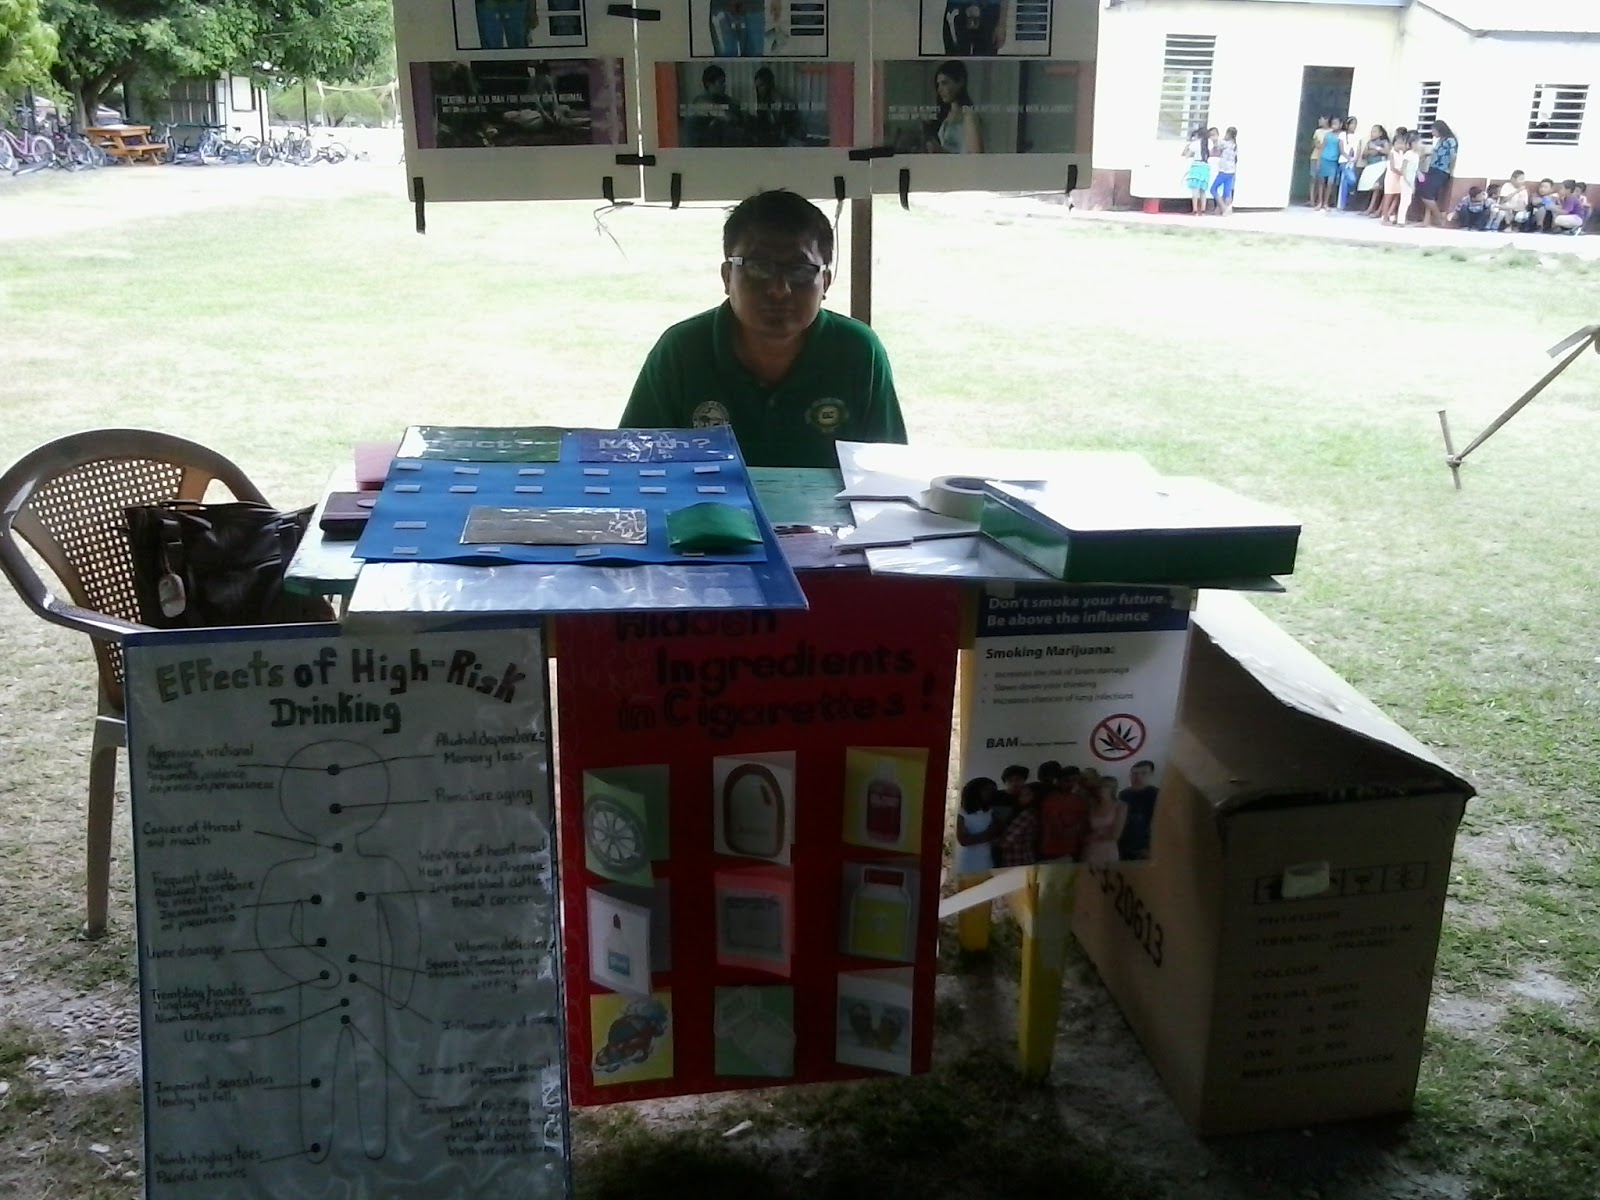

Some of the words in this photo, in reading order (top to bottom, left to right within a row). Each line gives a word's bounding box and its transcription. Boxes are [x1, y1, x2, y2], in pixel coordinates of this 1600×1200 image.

[988, 594, 1030, 609] Don't
[1032, 595, 1079, 608] smoke
[1081, 597, 1116, 609] your
[986, 613, 1006, 627] Be
[1007, 611, 1053, 625] above
[1056, 611, 1080, 624] the
[1082, 609, 1150, 623] influence
[985, 645, 1043, 661] Smoking
[1045, 645, 1116, 659] Marijuana:
[293, 646, 337, 689] of
[656, 639, 917, 698] Ingredients
[986, 736, 1019, 749] BAM
